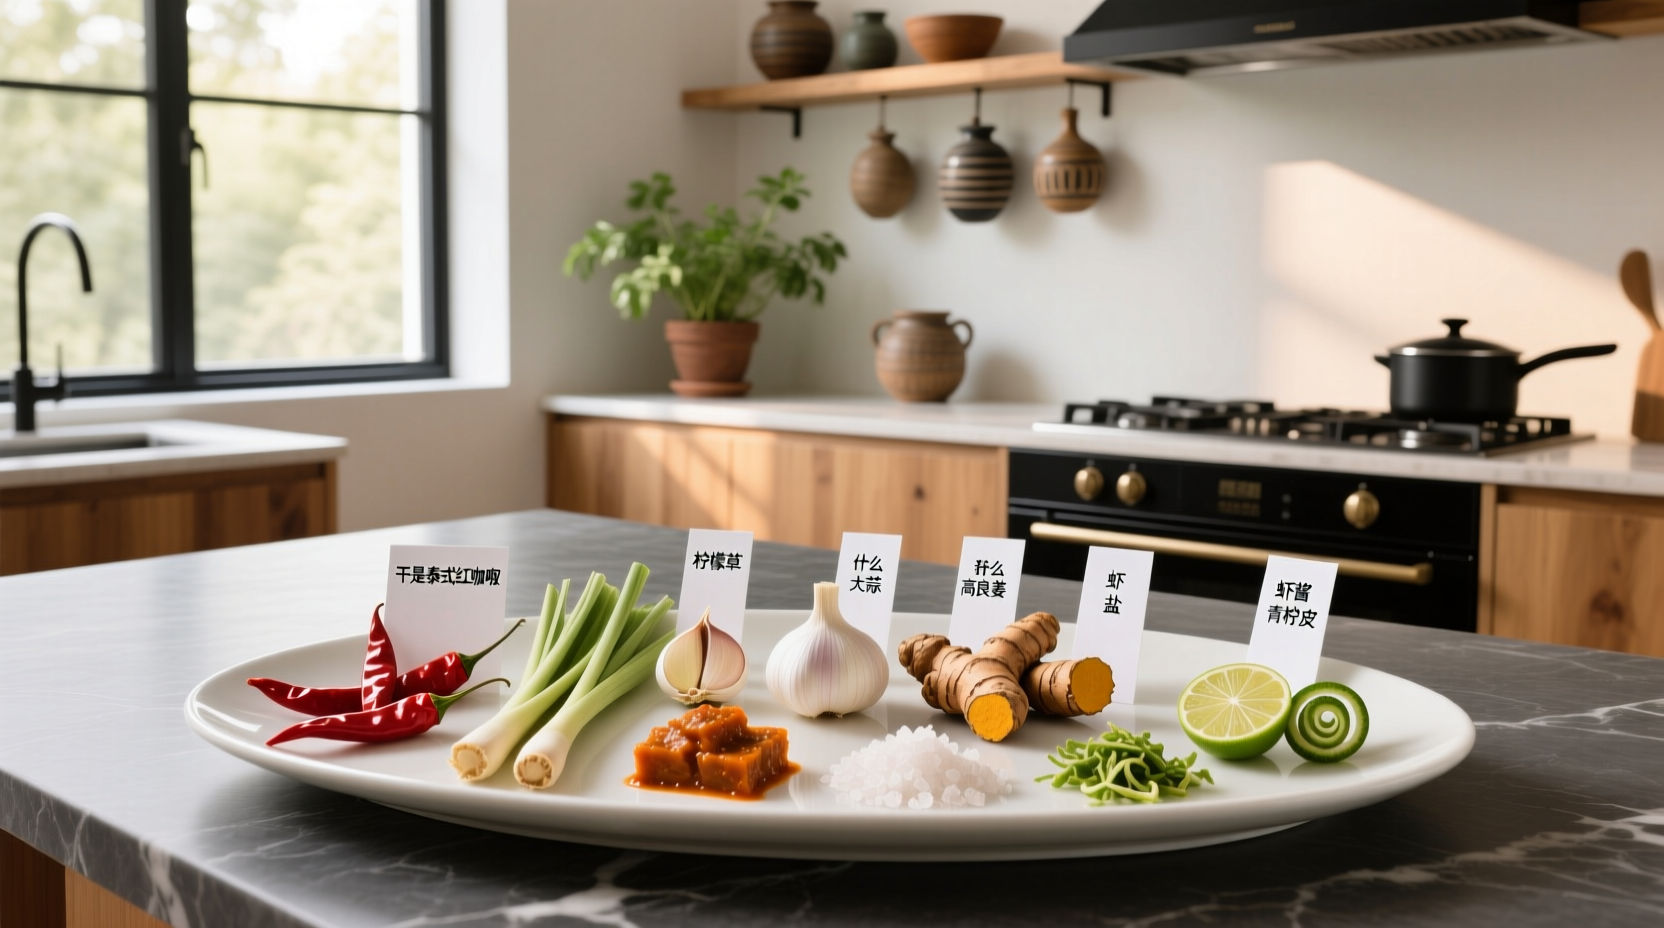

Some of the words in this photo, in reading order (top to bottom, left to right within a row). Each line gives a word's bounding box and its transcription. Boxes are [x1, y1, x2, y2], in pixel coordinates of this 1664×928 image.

[853, 553, 883, 572] 什么
[849, 575, 882, 594] 大蒜
[960, 577, 1007, 599] 高良姜
[1105, 569, 1127, 590] 虾
[1274, 579, 1313, 603] 虾酱
[1103, 593, 1124, 615] 盐
[1267, 603, 1318, 629] 青柠皮
